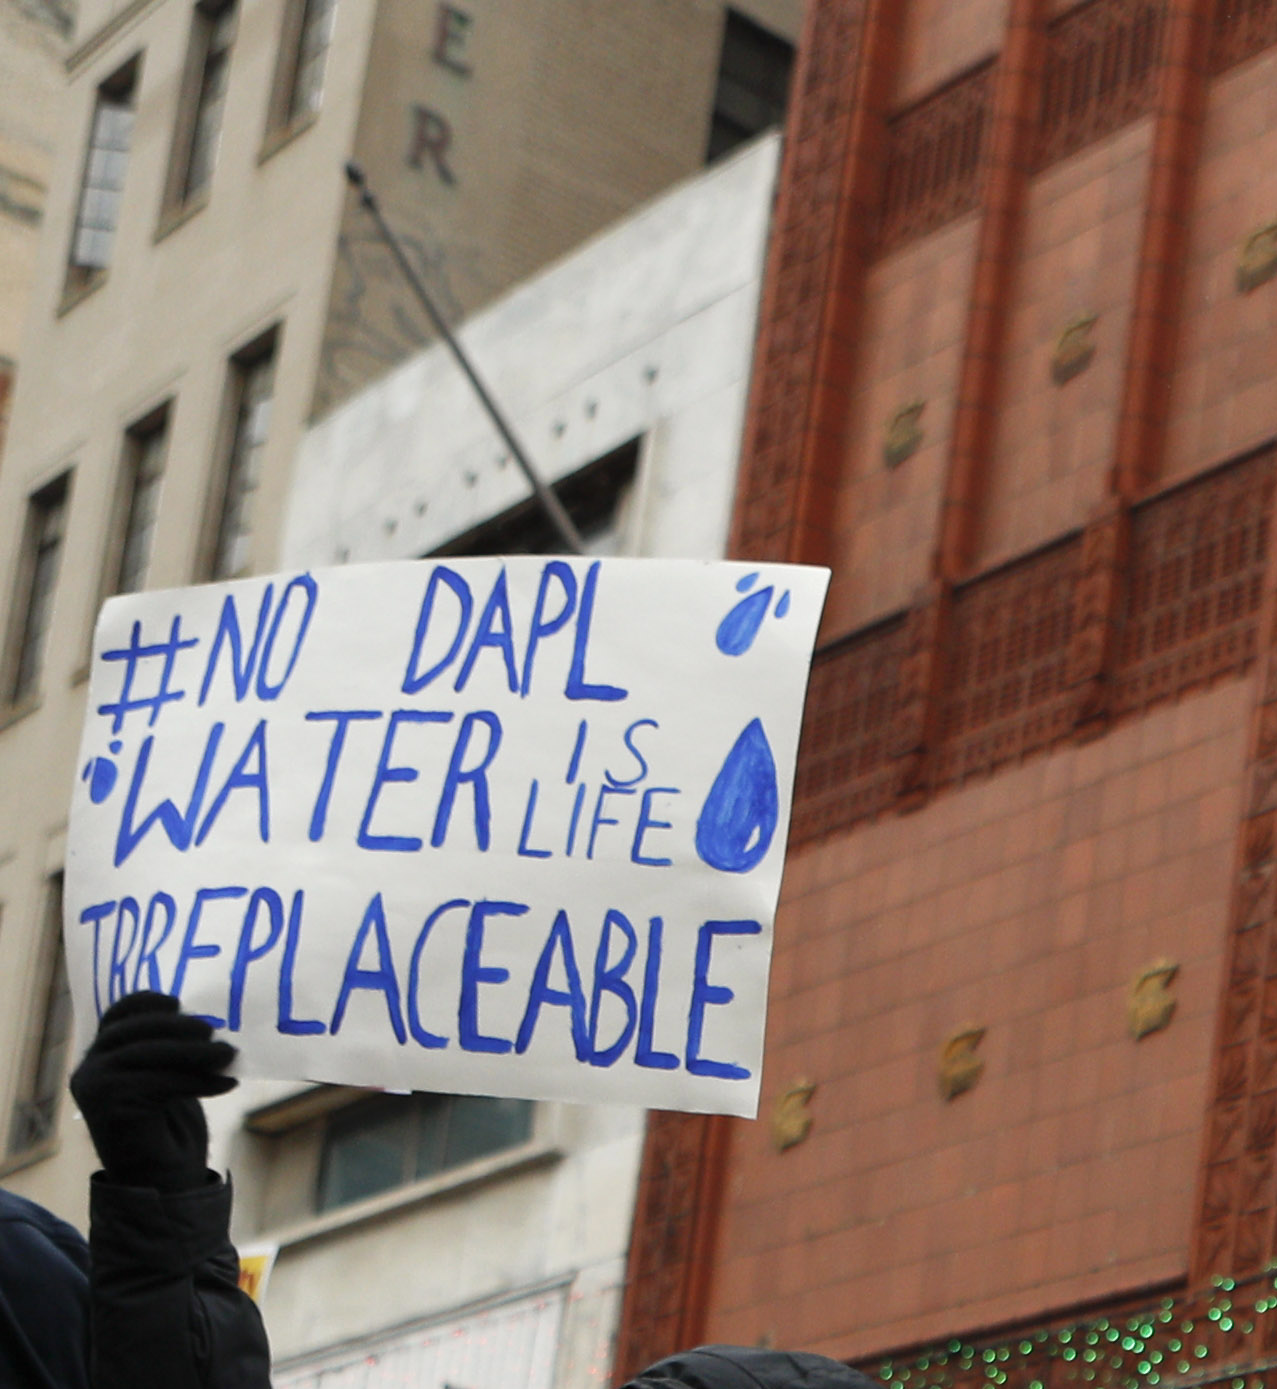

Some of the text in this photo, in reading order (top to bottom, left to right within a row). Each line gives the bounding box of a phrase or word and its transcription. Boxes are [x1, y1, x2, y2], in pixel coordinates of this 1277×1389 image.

[98, 560, 628, 735] #NO DAPL
[114, 709, 659, 868] WATER IS
[517, 778, 681, 867] LIFE
